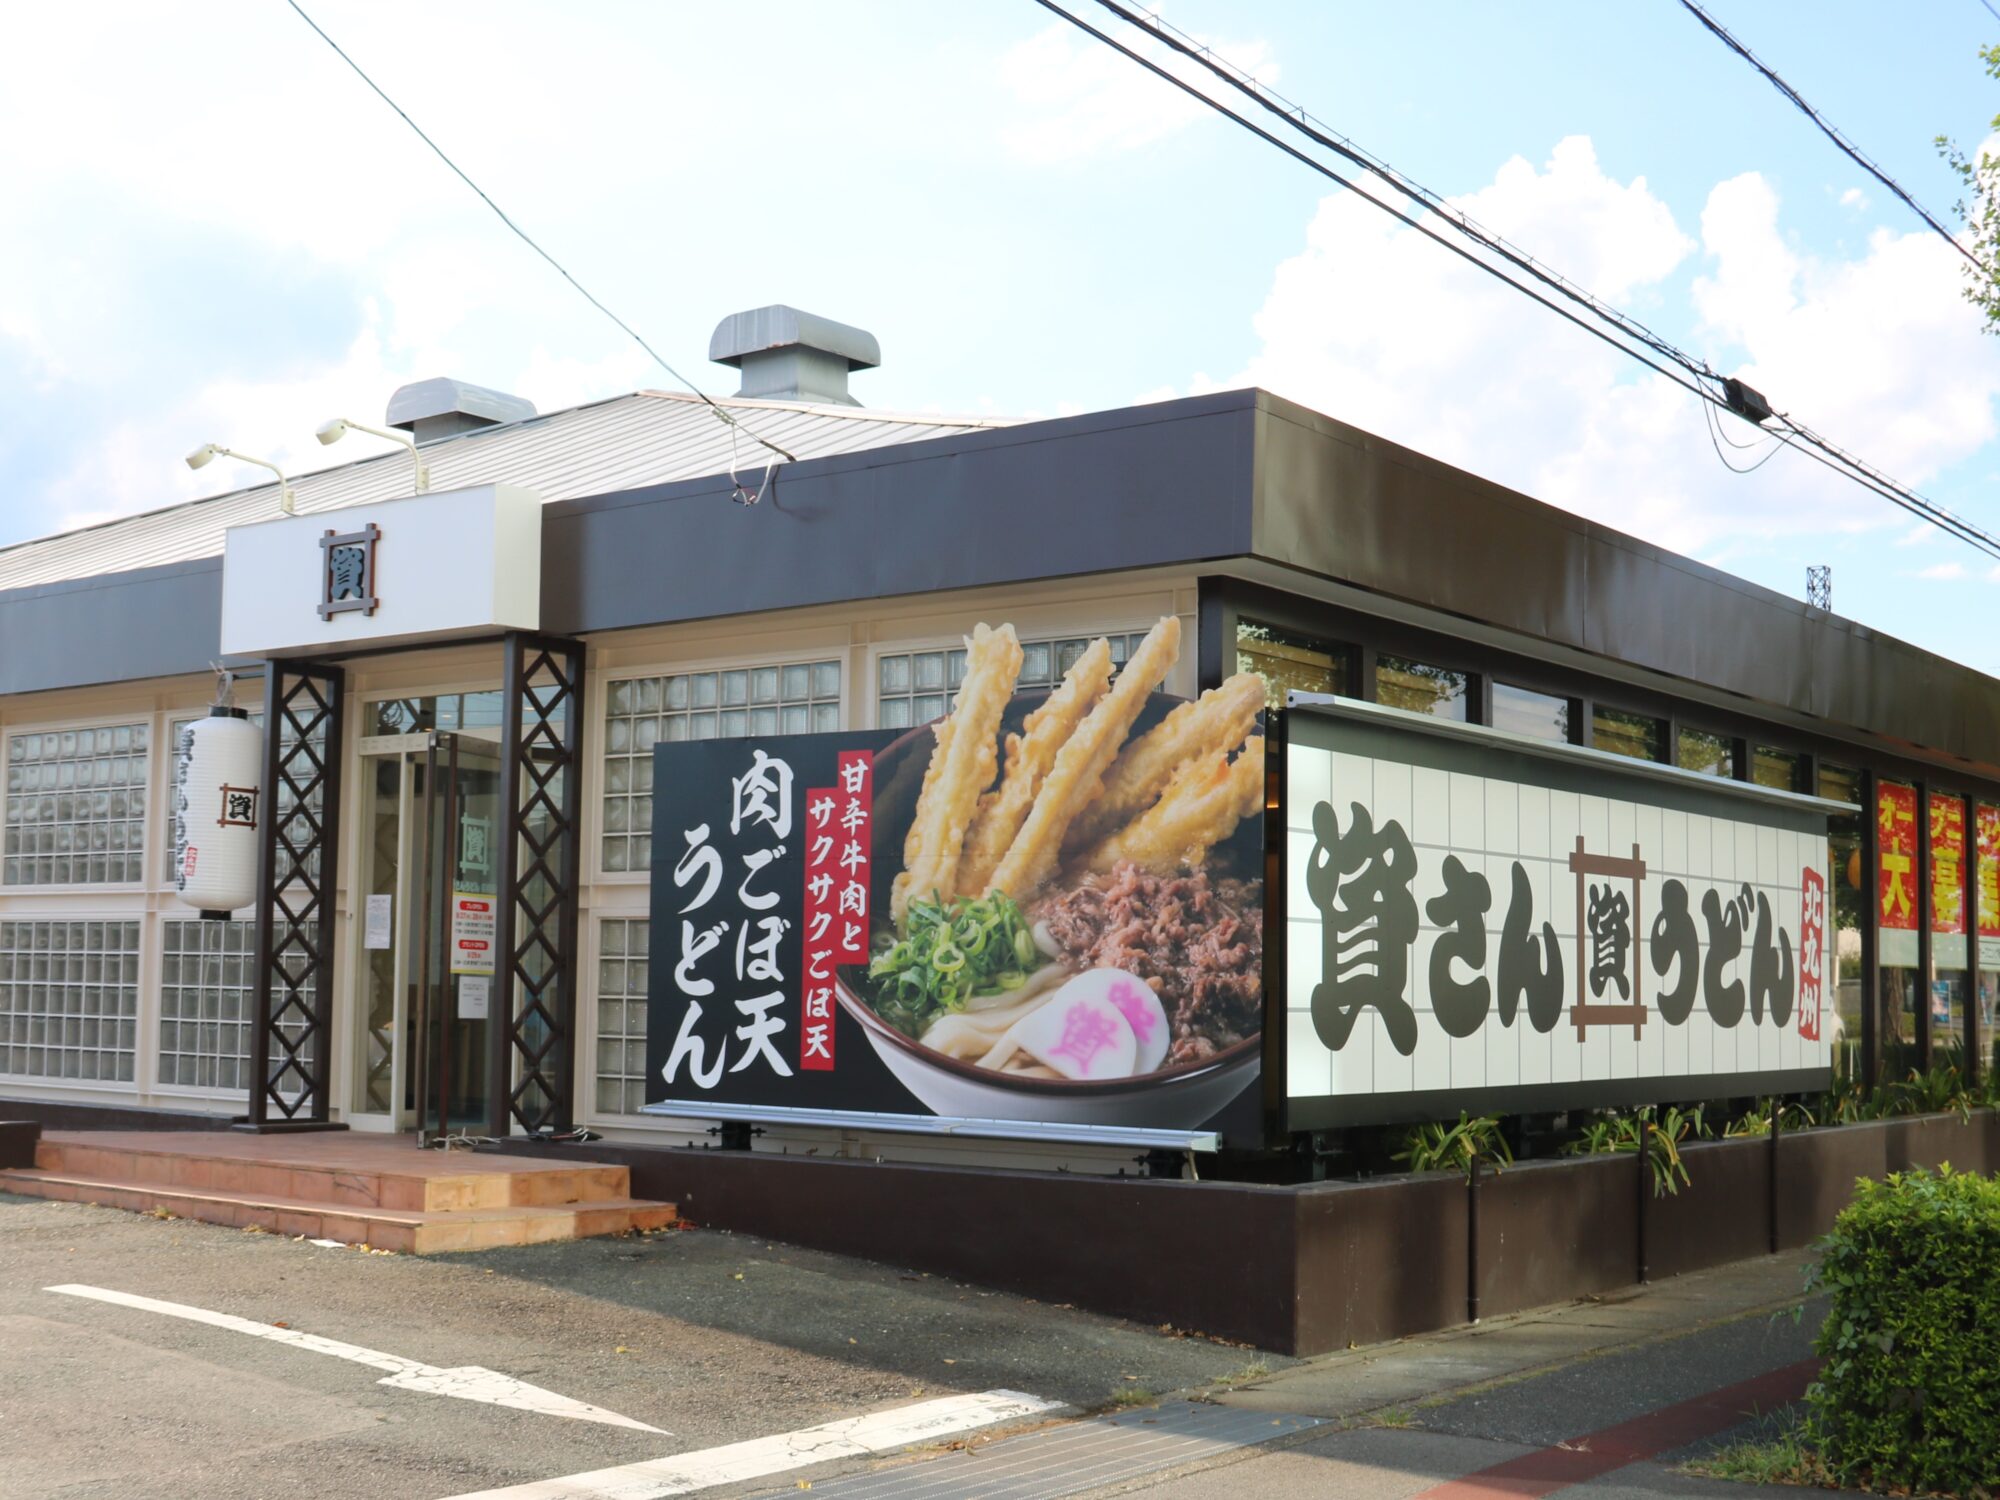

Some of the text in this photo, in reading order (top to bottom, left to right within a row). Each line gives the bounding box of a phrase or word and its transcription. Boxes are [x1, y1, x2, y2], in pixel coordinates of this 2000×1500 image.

[330, 546, 365, 600] 資
[229, 793, 252, 821] 資
[838, 757, 869, 952] 甘辛牛肉と
[661, 822, 730, 1090] うどん
[728, 748, 795, 1077] 肉ごぼ天
[803, 796, 836, 1060] サクサクごぼ天
[1800, 880, 1822, 1037] 北九州
